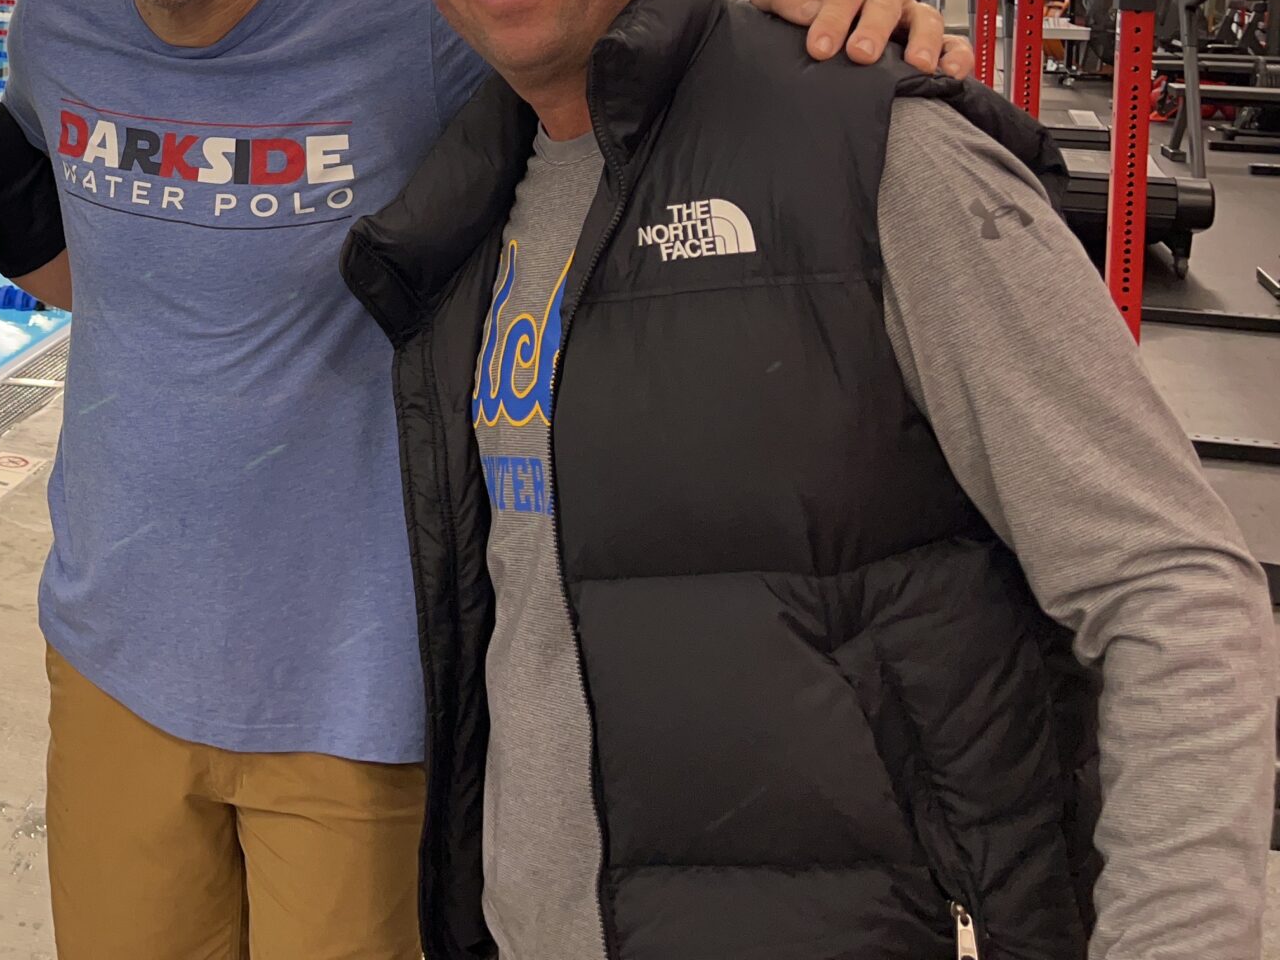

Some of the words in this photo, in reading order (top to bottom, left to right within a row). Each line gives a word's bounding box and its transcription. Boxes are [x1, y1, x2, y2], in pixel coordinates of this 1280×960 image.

[58, 109, 355, 185] DARKSIDE
[62, 161, 185, 210] WATER
[213, 187, 354, 217] POLO
[666, 200, 711, 223] THE
[637, 218, 713, 246] NORTH
[660, 237, 717, 261] FACE
